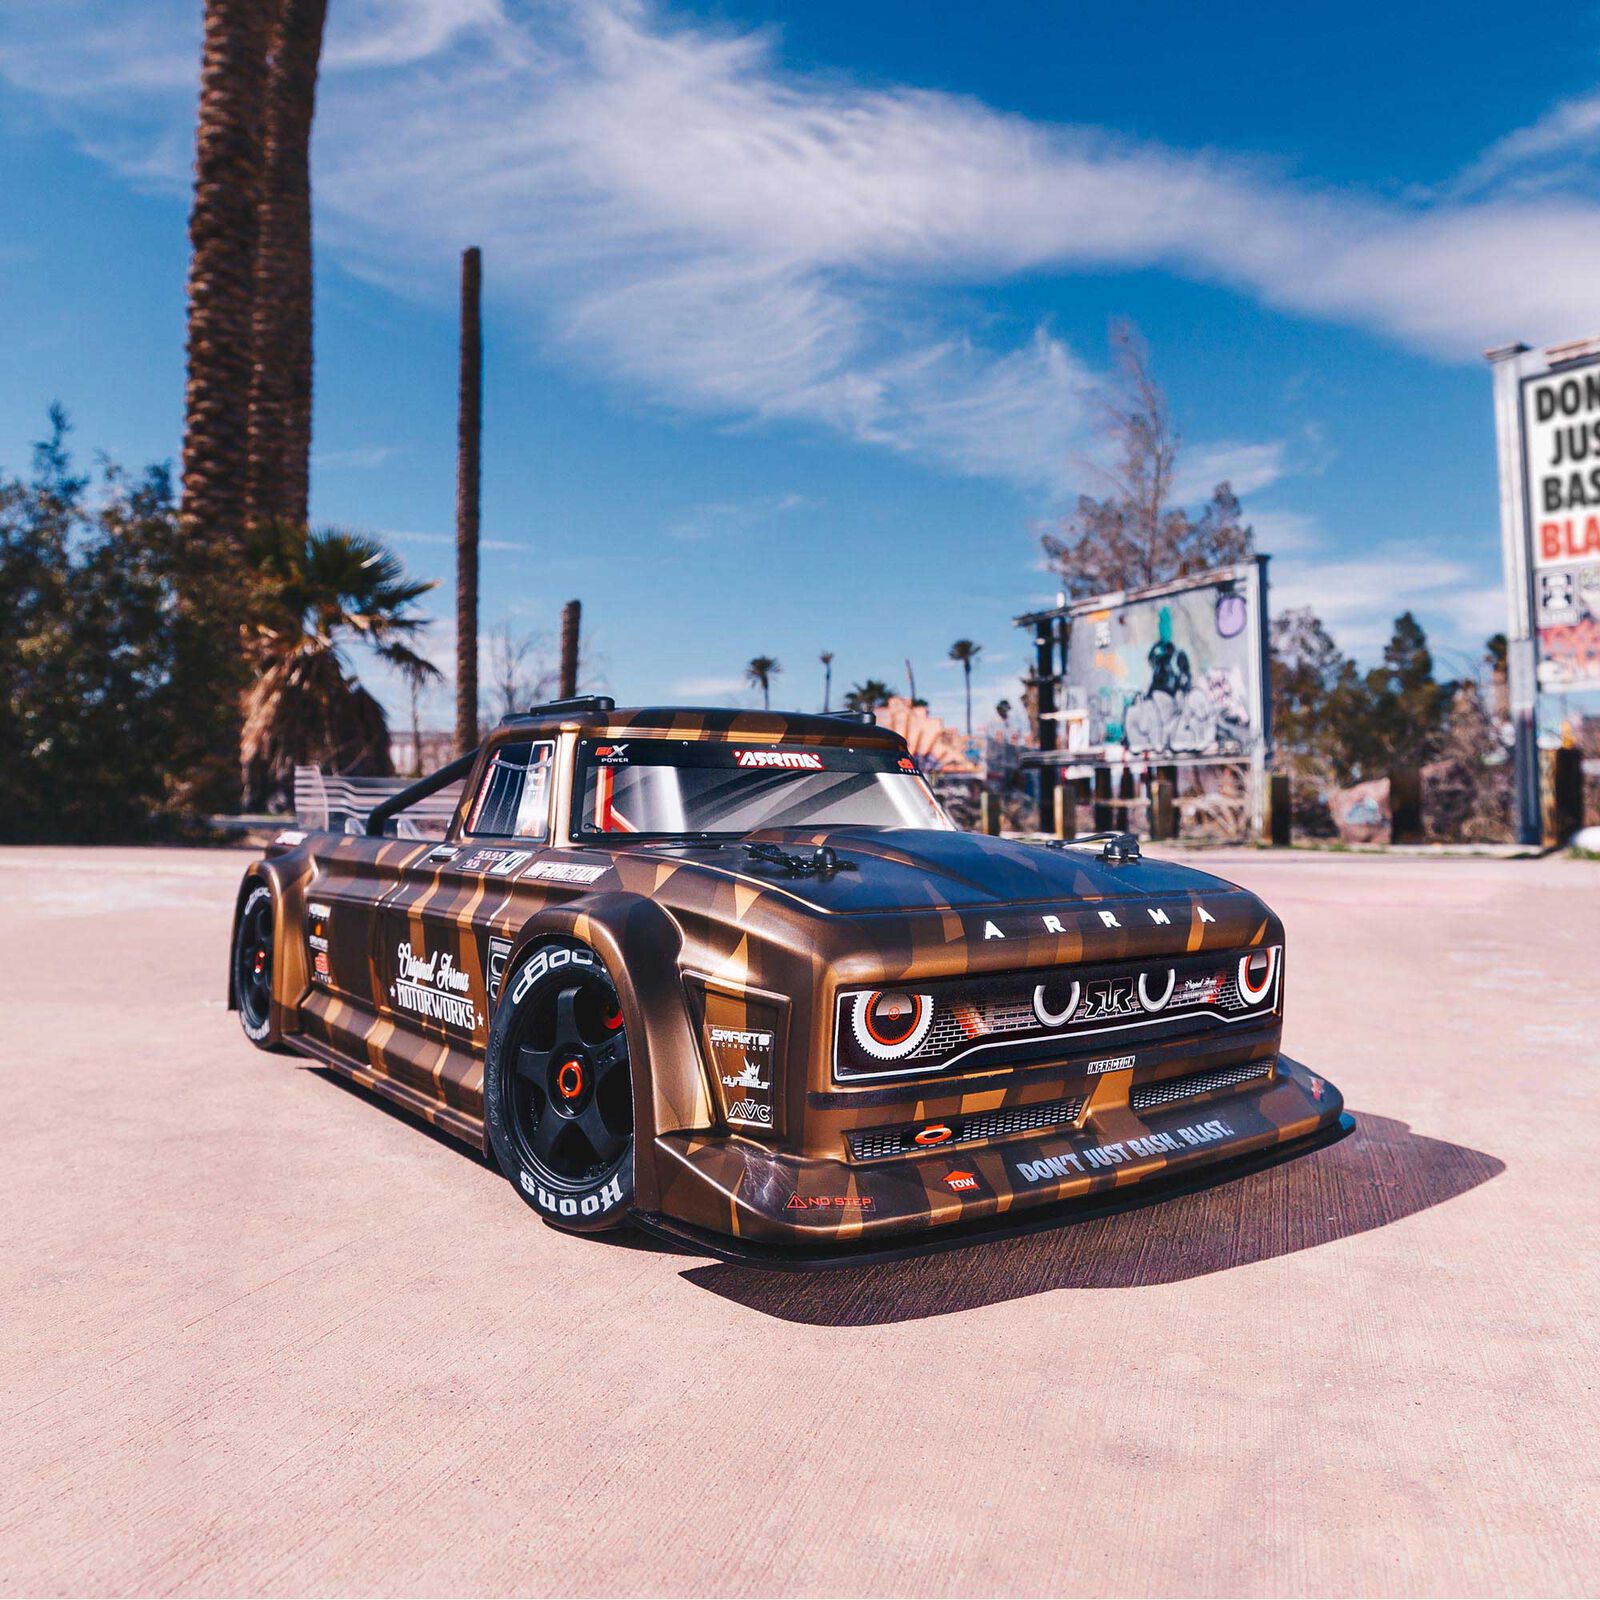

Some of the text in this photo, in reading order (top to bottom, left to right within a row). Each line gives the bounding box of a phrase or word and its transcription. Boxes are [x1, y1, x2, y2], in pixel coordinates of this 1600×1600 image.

[396, 983, 476, 1031] MOTORWORKS
[710, 1041, 770, 1052] TECHNOLOGY
[1087, 1055, 1136, 1074] INFRACTION
[1016, 1119, 1235, 1182] DON'T JUST BASH. BLAST.
[948, 1177, 976, 1189] TOW
[808, 1197, 872, 1206] NO STEP
